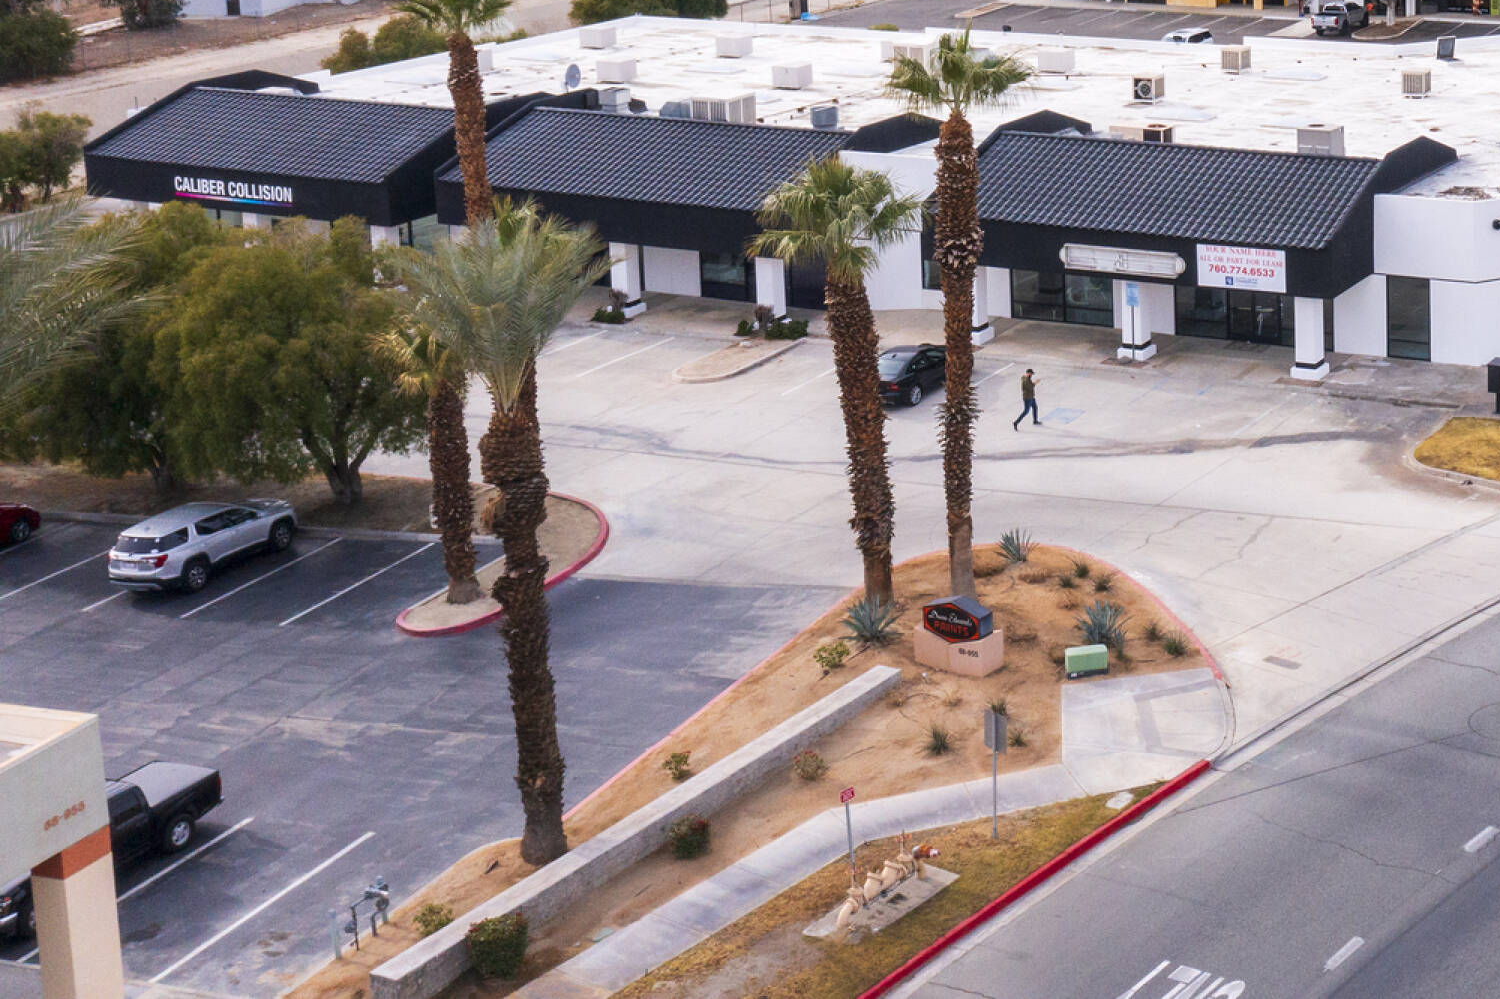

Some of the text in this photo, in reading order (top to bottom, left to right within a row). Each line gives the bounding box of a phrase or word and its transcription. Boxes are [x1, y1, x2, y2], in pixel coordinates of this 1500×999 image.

[173, 176, 294, 203] CALIBER COLLISION
[1208, 263, 1275, 278] 760.774.6533
[933, 620, 969, 637] PAINTS
